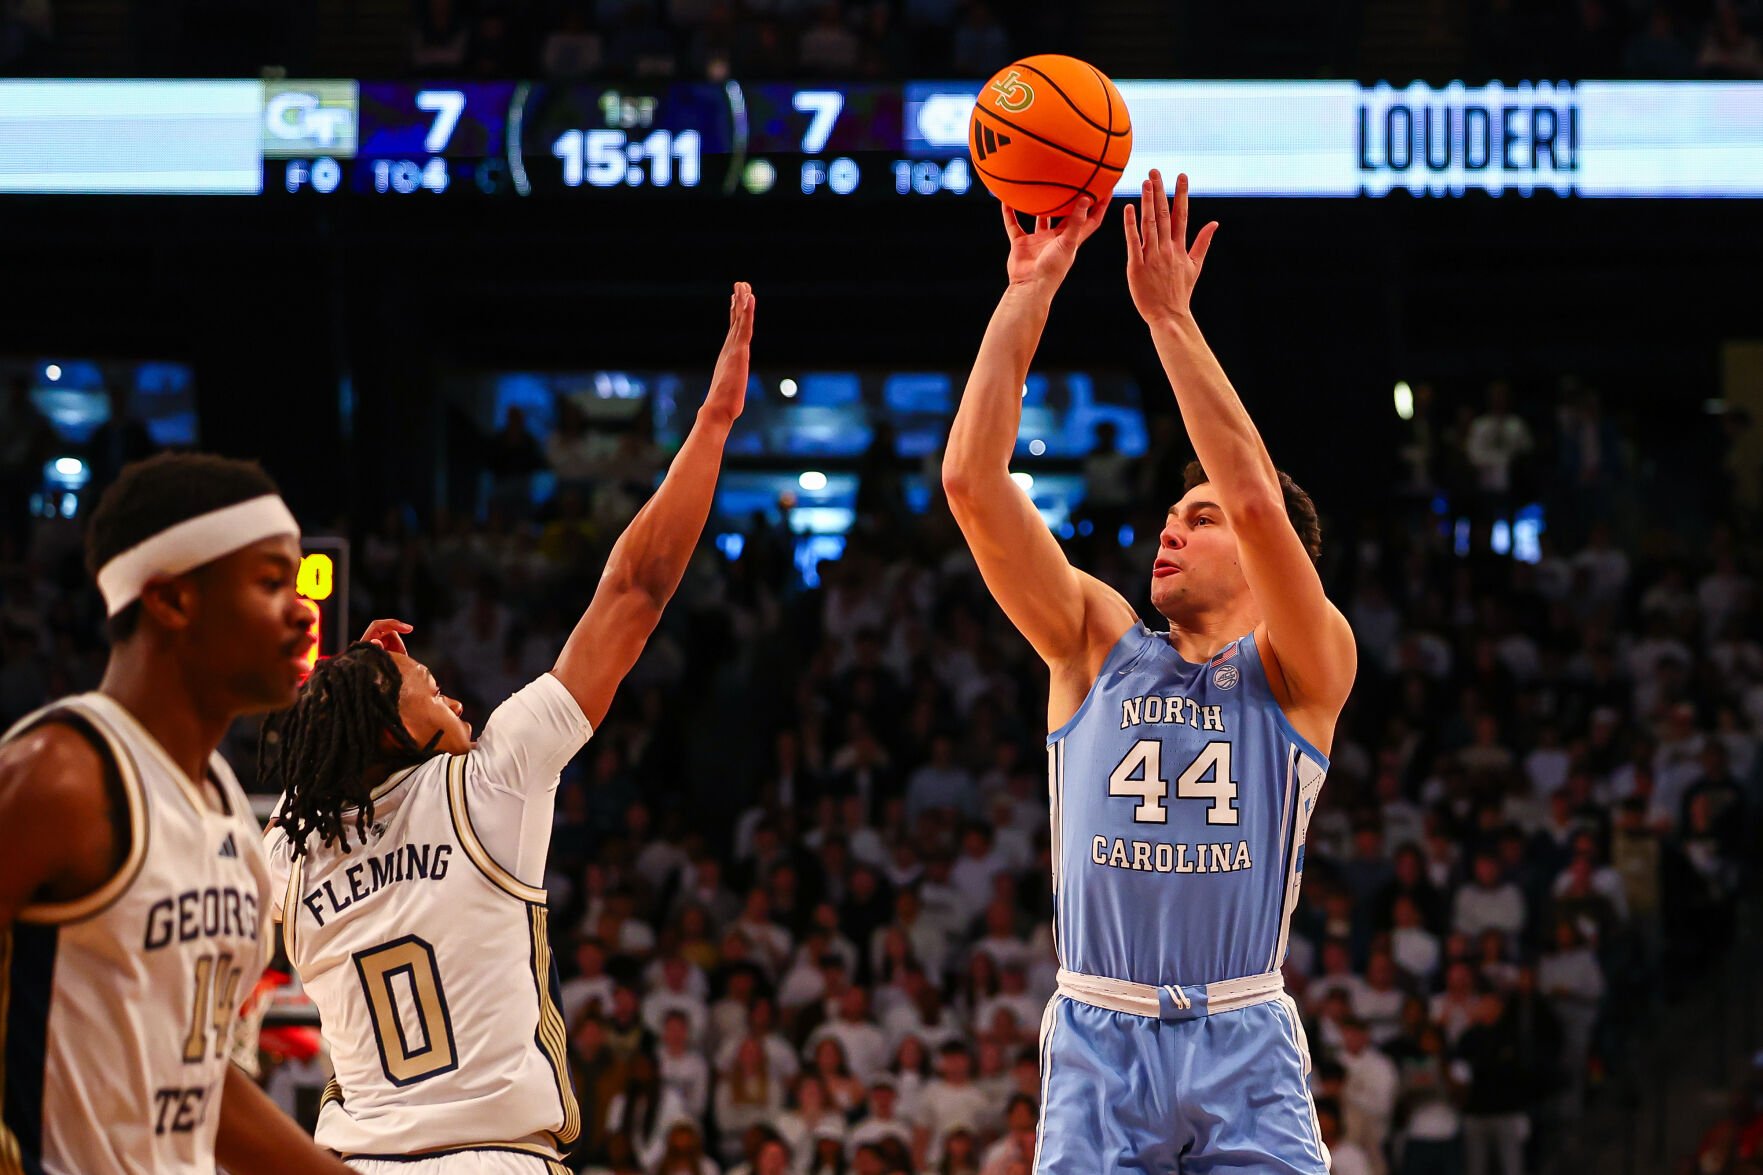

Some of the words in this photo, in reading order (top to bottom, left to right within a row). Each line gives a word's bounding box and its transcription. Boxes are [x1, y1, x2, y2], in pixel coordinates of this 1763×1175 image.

[415, 90, 466, 153] 7
[793, 91, 844, 153] 7
[552, 129, 701, 187] 15:11
[1120, 695, 1225, 732] NORTH
[1108, 739, 1239, 825] 44
[303, 843, 453, 927] FLEMING
[1091, 834, 1253, 874] CAROLINA
[353, 934, 459, 1087] 0
[155, 1080, 217, 1135] TE
